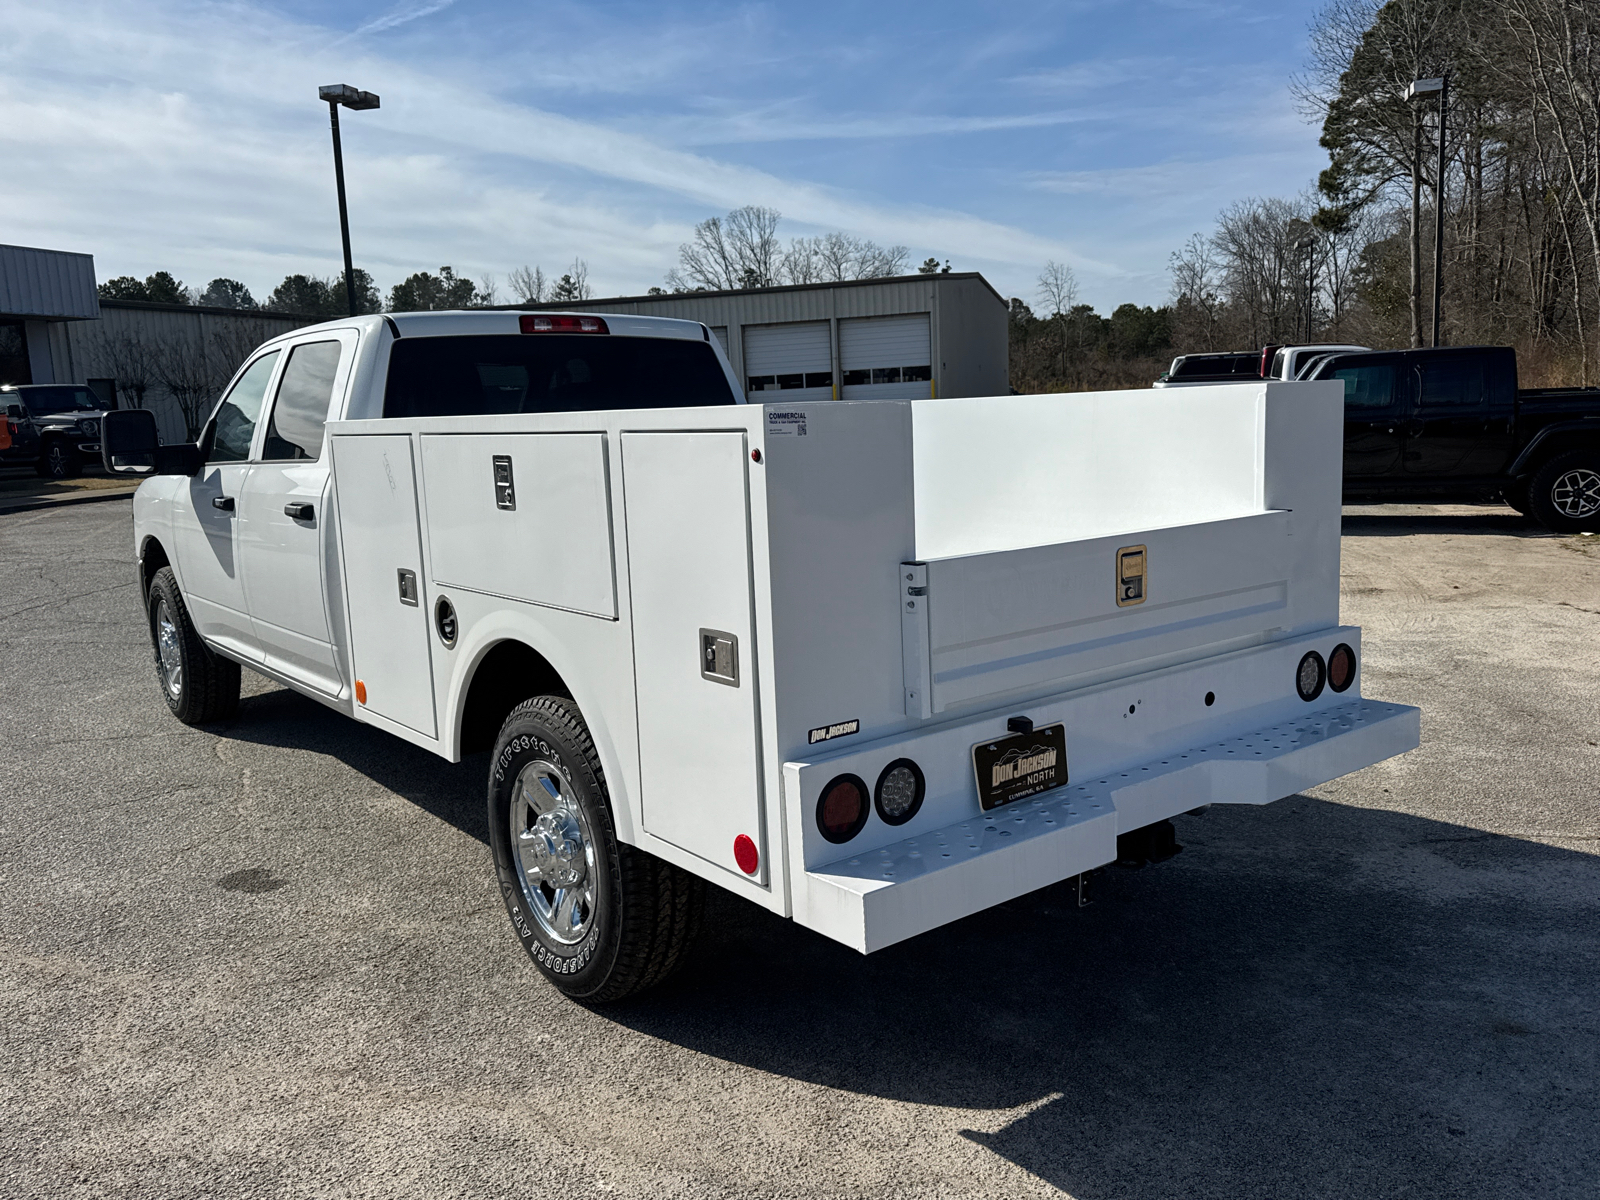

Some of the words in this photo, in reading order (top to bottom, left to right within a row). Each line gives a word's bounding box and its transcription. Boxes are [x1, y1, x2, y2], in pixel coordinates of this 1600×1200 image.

[769, 412, 806, 420] COMMERCIAL
[811, 729, 826, 743] DON
[826, 721, 857, 739] JACKSON
[992, 764, 1013, 787] DON
[1014, 750, 1057, 778] JACKSON
[1027, 769, 1055, 785] NORTH
[531, 926, 600, 974] TRANSFORCE
